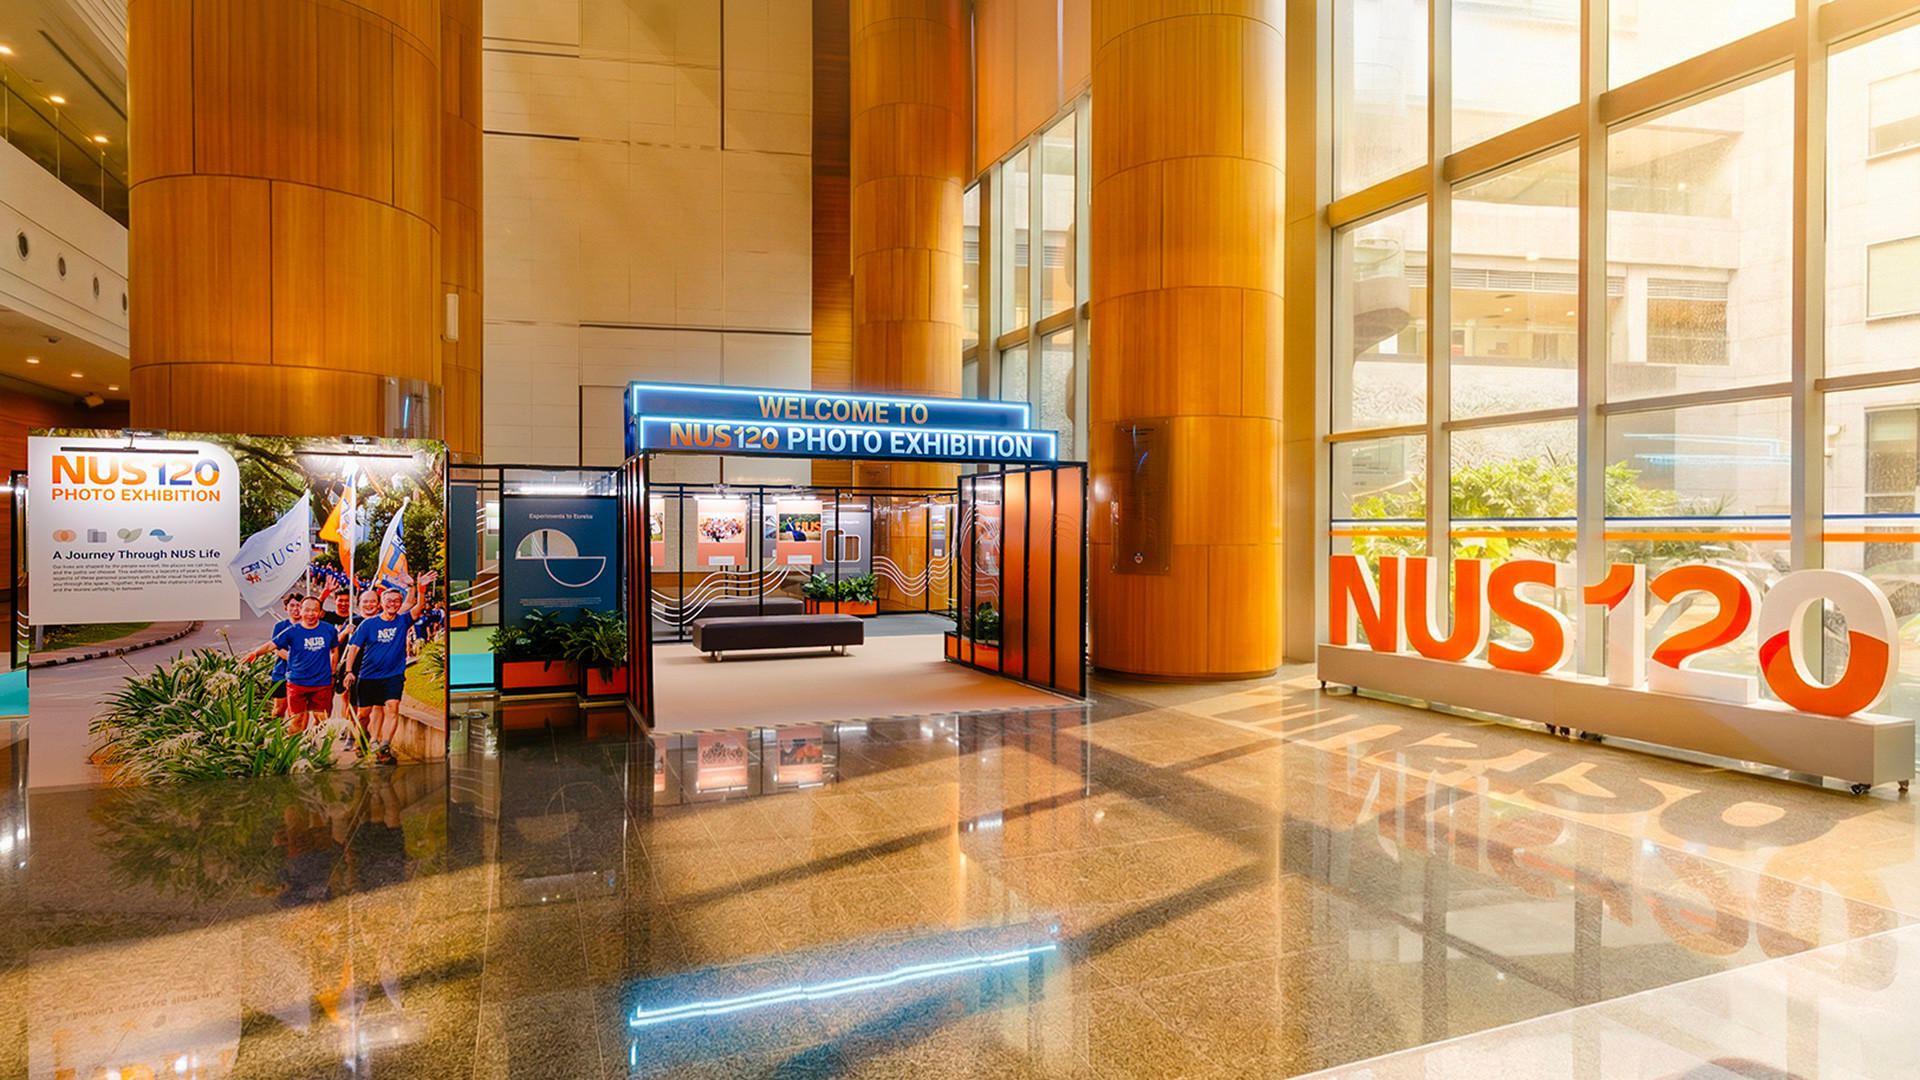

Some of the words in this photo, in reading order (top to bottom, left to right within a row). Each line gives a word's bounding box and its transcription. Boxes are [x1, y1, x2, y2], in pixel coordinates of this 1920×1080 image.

[758, 396, 889, 423] WELCOME
[895, 402, 928, 424] TO
[787, 428, 882, 454] PHOTO
[890, 431, 1032, 457] EXHIBITION
[52, 488, 115, 501] PHOTO
[121, 489, 221, 502] EXHIBITION
[53, 550, 62, 560] A
[66, 550, 115, 561] Journey
[118, 549, 167, 561] Through
[171, 550, 196, 559] NUS
[199, 549, 221, 559] Life
